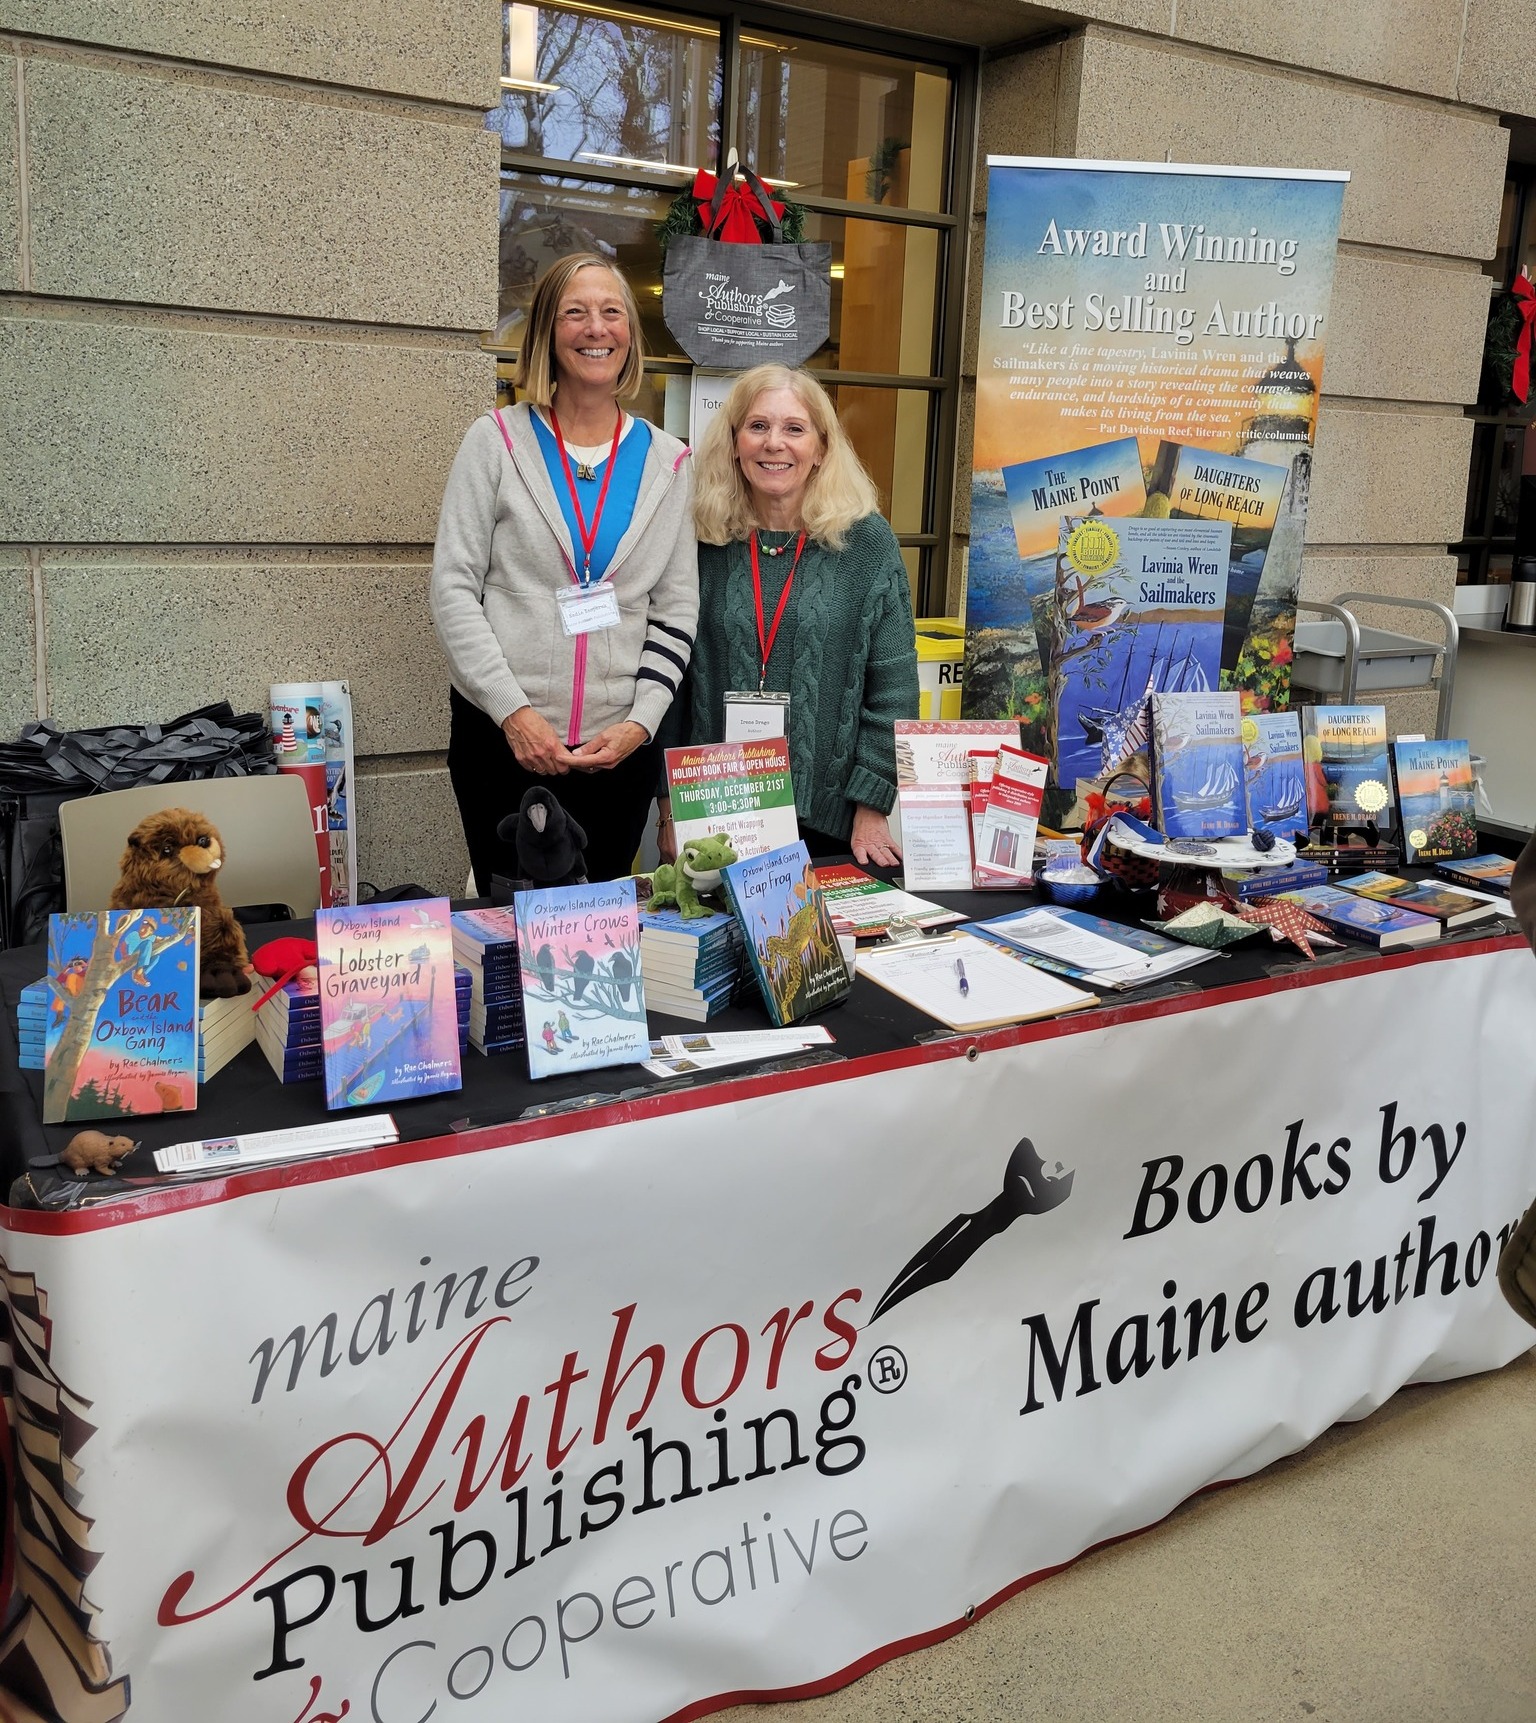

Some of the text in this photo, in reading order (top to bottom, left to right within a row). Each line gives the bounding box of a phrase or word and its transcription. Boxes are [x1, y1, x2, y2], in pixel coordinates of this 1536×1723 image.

[1036, 217, 1299, 277] Award Winning
[705, 271, 731, 282] maine
[1143, 267, 1187, 293] and
[698, 281, 763, 305] Authors
[715, 311, 762, 326] Cooperative
[998, 290, 1324, 345] Best Selling Author
[1060, 345, 1068, 356] a
[1069, 343, 1098, 359] fine
[1096, 345, 1148, 361] tapestry,
[1151, 346, 1198, 361] Lavinia
[1202, 349, 1238, 363] Wren
[1239, 351, 1264, 364] and
[1267, 352, 1288, 365] the
[992, 357, 1312, 381] Sailmakers is a moving historical drama that weaves
[1008, 374, 1293, 397] many people into a story revealing the courage,
[1009, 388, 1265, 412] endurance, and hardships of a community
[1060, 406, 1098, 419] makes
[1100, 406, 1114, 418] its
[1117, 406, 1152, 423] living
[1153, 409, 1186, 426] from
[1186, 410, 1207, 423] the
[1099, 423, 1311, 442] Pat Davidson Reef, literary critic/columnist
[1044, 469, 1068, 487] THE
[1193, 465, 1261, 494] DAUGHTERS
[1031, 475, 1120, 512] MAINE POINT
[1180, 487, 1265, 517] OF LONG REACH
[1141, 555, 1218, 575] Lavinia Wren
[1166, 576, 1185, 584] and the
[1139, 581, 1216, 605] Sailmakers
[1195, 709, 1235, 720] Lavinia Wren
[1328, 714, 1371, 725] DAUGHTERS
[1195, 723, 1235, 736] Sailmakers
[1267, 729, 1297, 740] Lavinia Wren
[1322, 727, 1377, 737] OF LONG REACH
[681, 747, 777, 767] Maine Authors Publishing
[1269, 743, 1299, 754] Sailmakers
[672, 756, 787, 780] HOLIDAY BOOK FAIR & OPEN HOUSE
[1409, 756, 1459, 771] MAINE POINT
[679, 779, 785, 804] THURSDAY, DECEMBER 21ST
[712, 818, 765, 834] Free Gift Wrapping
[1332, 813, 1377, 821] IRENE DRAGO
[734, 832, 758, 844] Signings
[742, 851, 801, 879] Oxbow Island Gang
[743, 870, 792, 899] Leap Frog
[534, 896, 624, 915] Oxbow Island Gang
[331, 915, 400, 935] Oxbow Island
[353, 928, 381, 943] Gang
[531, 913, 629, 940] Winter Crows
[339, 947, 404, 976] Lobster
[326, 964, 421, 998] Graveyard
[809, 965, 843, 987] by Rae Chalmers
[96, 1017, 194, 1042] Oxbow Island
[582, 1032, 637, 1049] by Rae Chalmers
[125, 1036, 166, 1054] Gang
[109, 1056, 183, 1075] by Rae Chalmers
[394, 1059, 453, 1077] by Rae Chalmers
[1122, 1101, 1467, 1241] Books by
[1019, 1210, 1529, 1417] Maine author
[248, 1255, 541, 1405] maine
[157, 1285, 865, 1629] Authors
[369, 1508, 870, 1723] Cooperative
